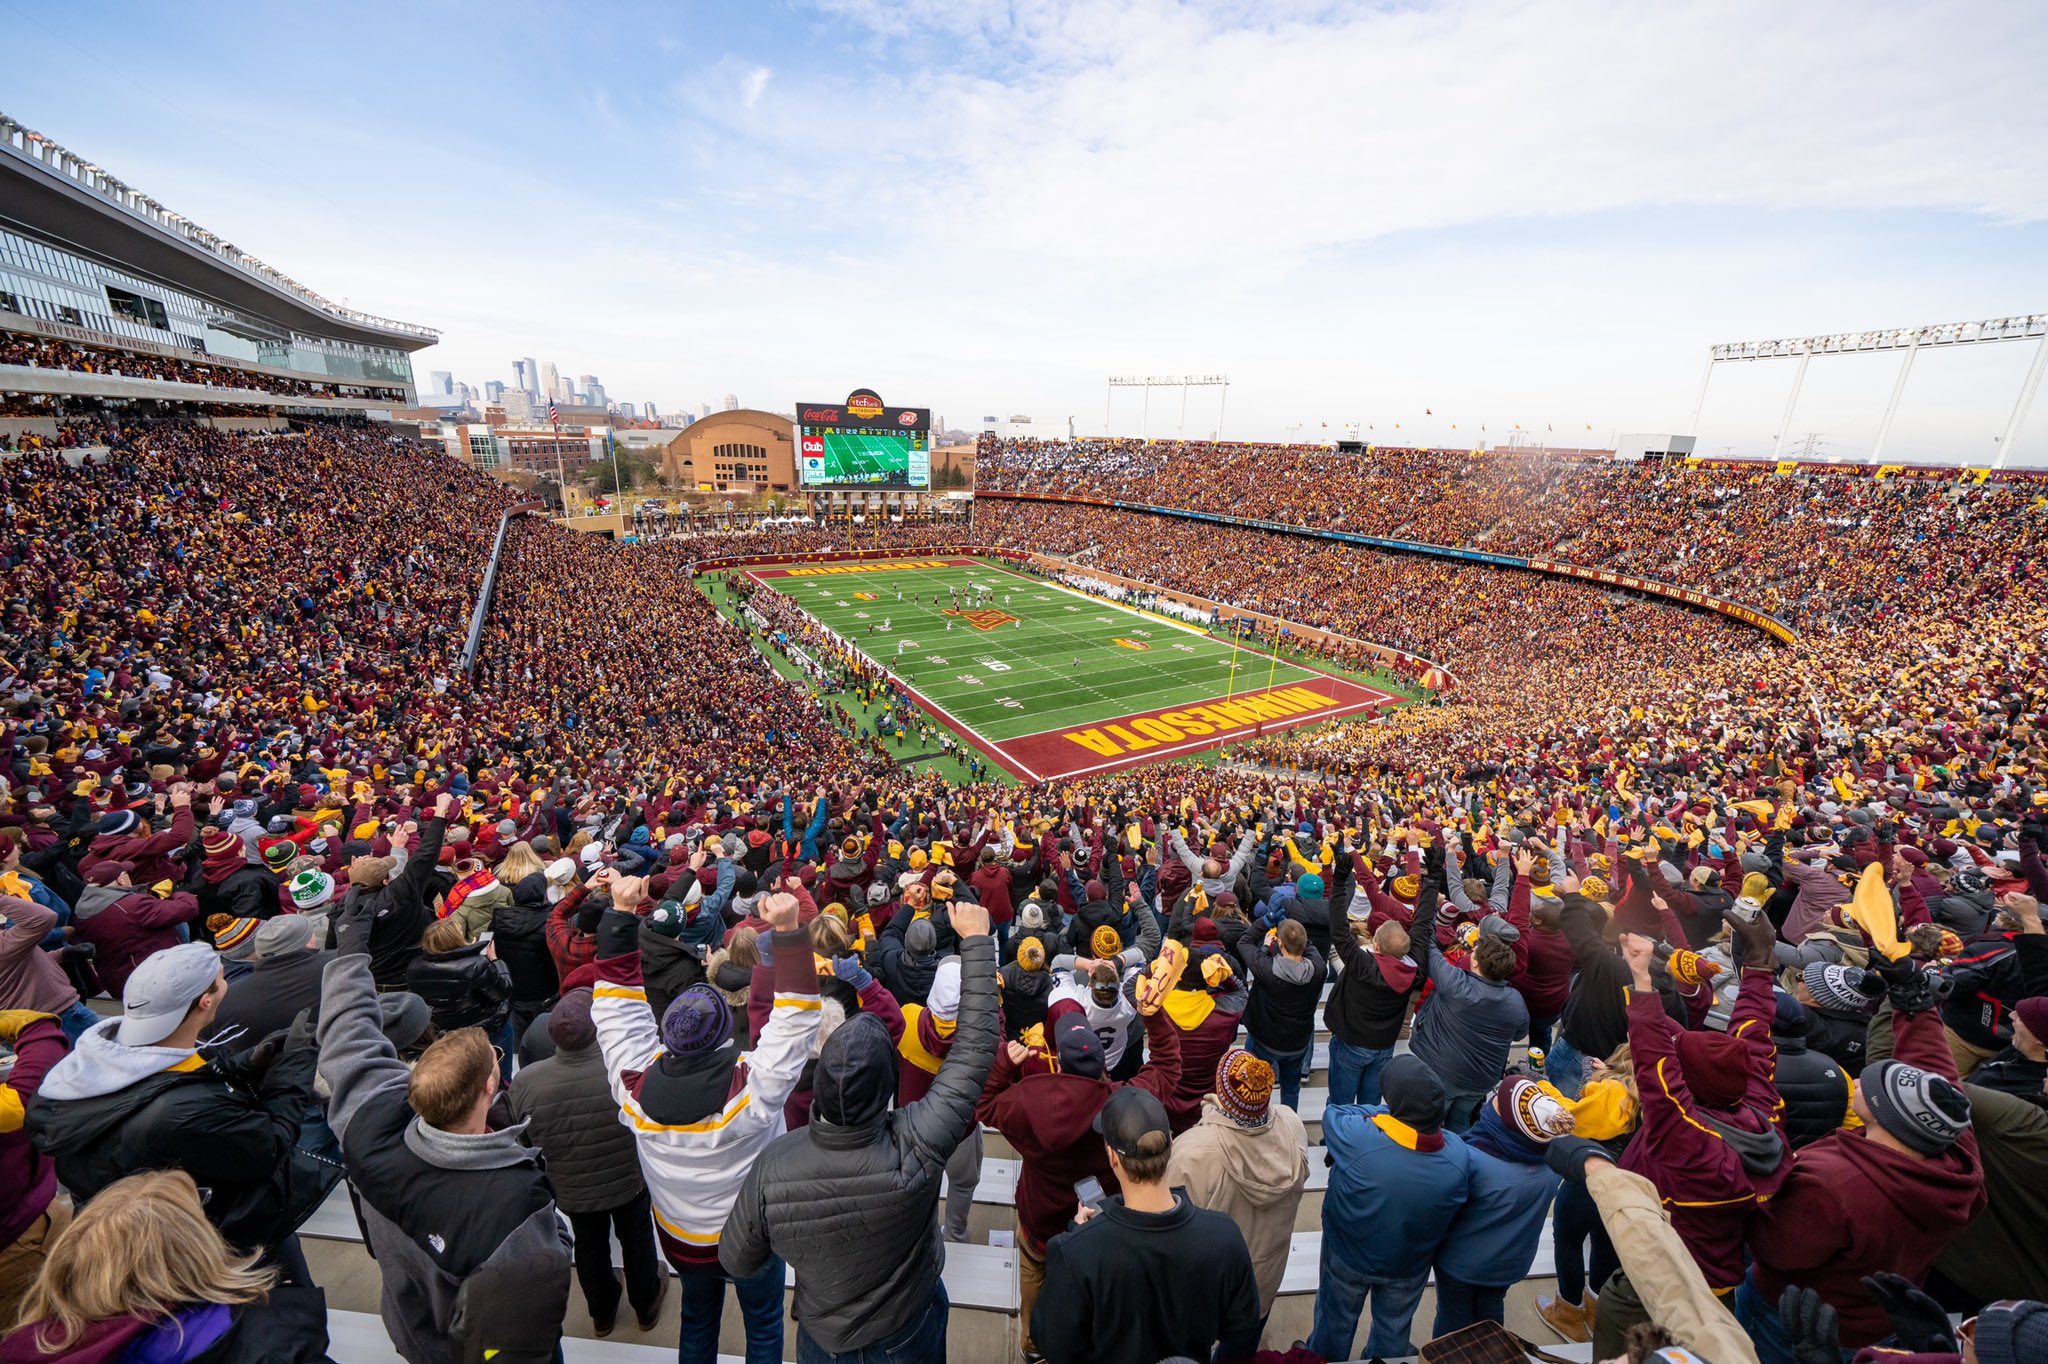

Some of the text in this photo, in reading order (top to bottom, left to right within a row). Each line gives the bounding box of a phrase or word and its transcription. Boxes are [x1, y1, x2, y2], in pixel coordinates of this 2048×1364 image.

[35, 320, 161, 353] UNIVERSITY OF MINNESOTA
[902, 414, 915, 422] DQ
[803, 441, 823, 451] Cub
[784, 560, 950, 577] MINNESOTA
[1531, 560, 1548, 570] 1900
[1553, 564, 1571, 574] 1903
[1576, 568, 1594, 578] 1904
[1598, 572, 1617, 583] 1906
[1621, 576, 1639, 587] 1909
[1643, 581, 1661, 592] 1910
[1665, 586, 1681, 598] 1911
[1684, 592, 1703, 603] 1915
[1705, 598, 1721, 609] 1927
[1726, 605, 1742, 616] BIG
[1743, 610, 1756, 622] TEN
[1061, 686, 1341, 758] MINNESOTA
[1848, 1041, 1862, 1052] 27
